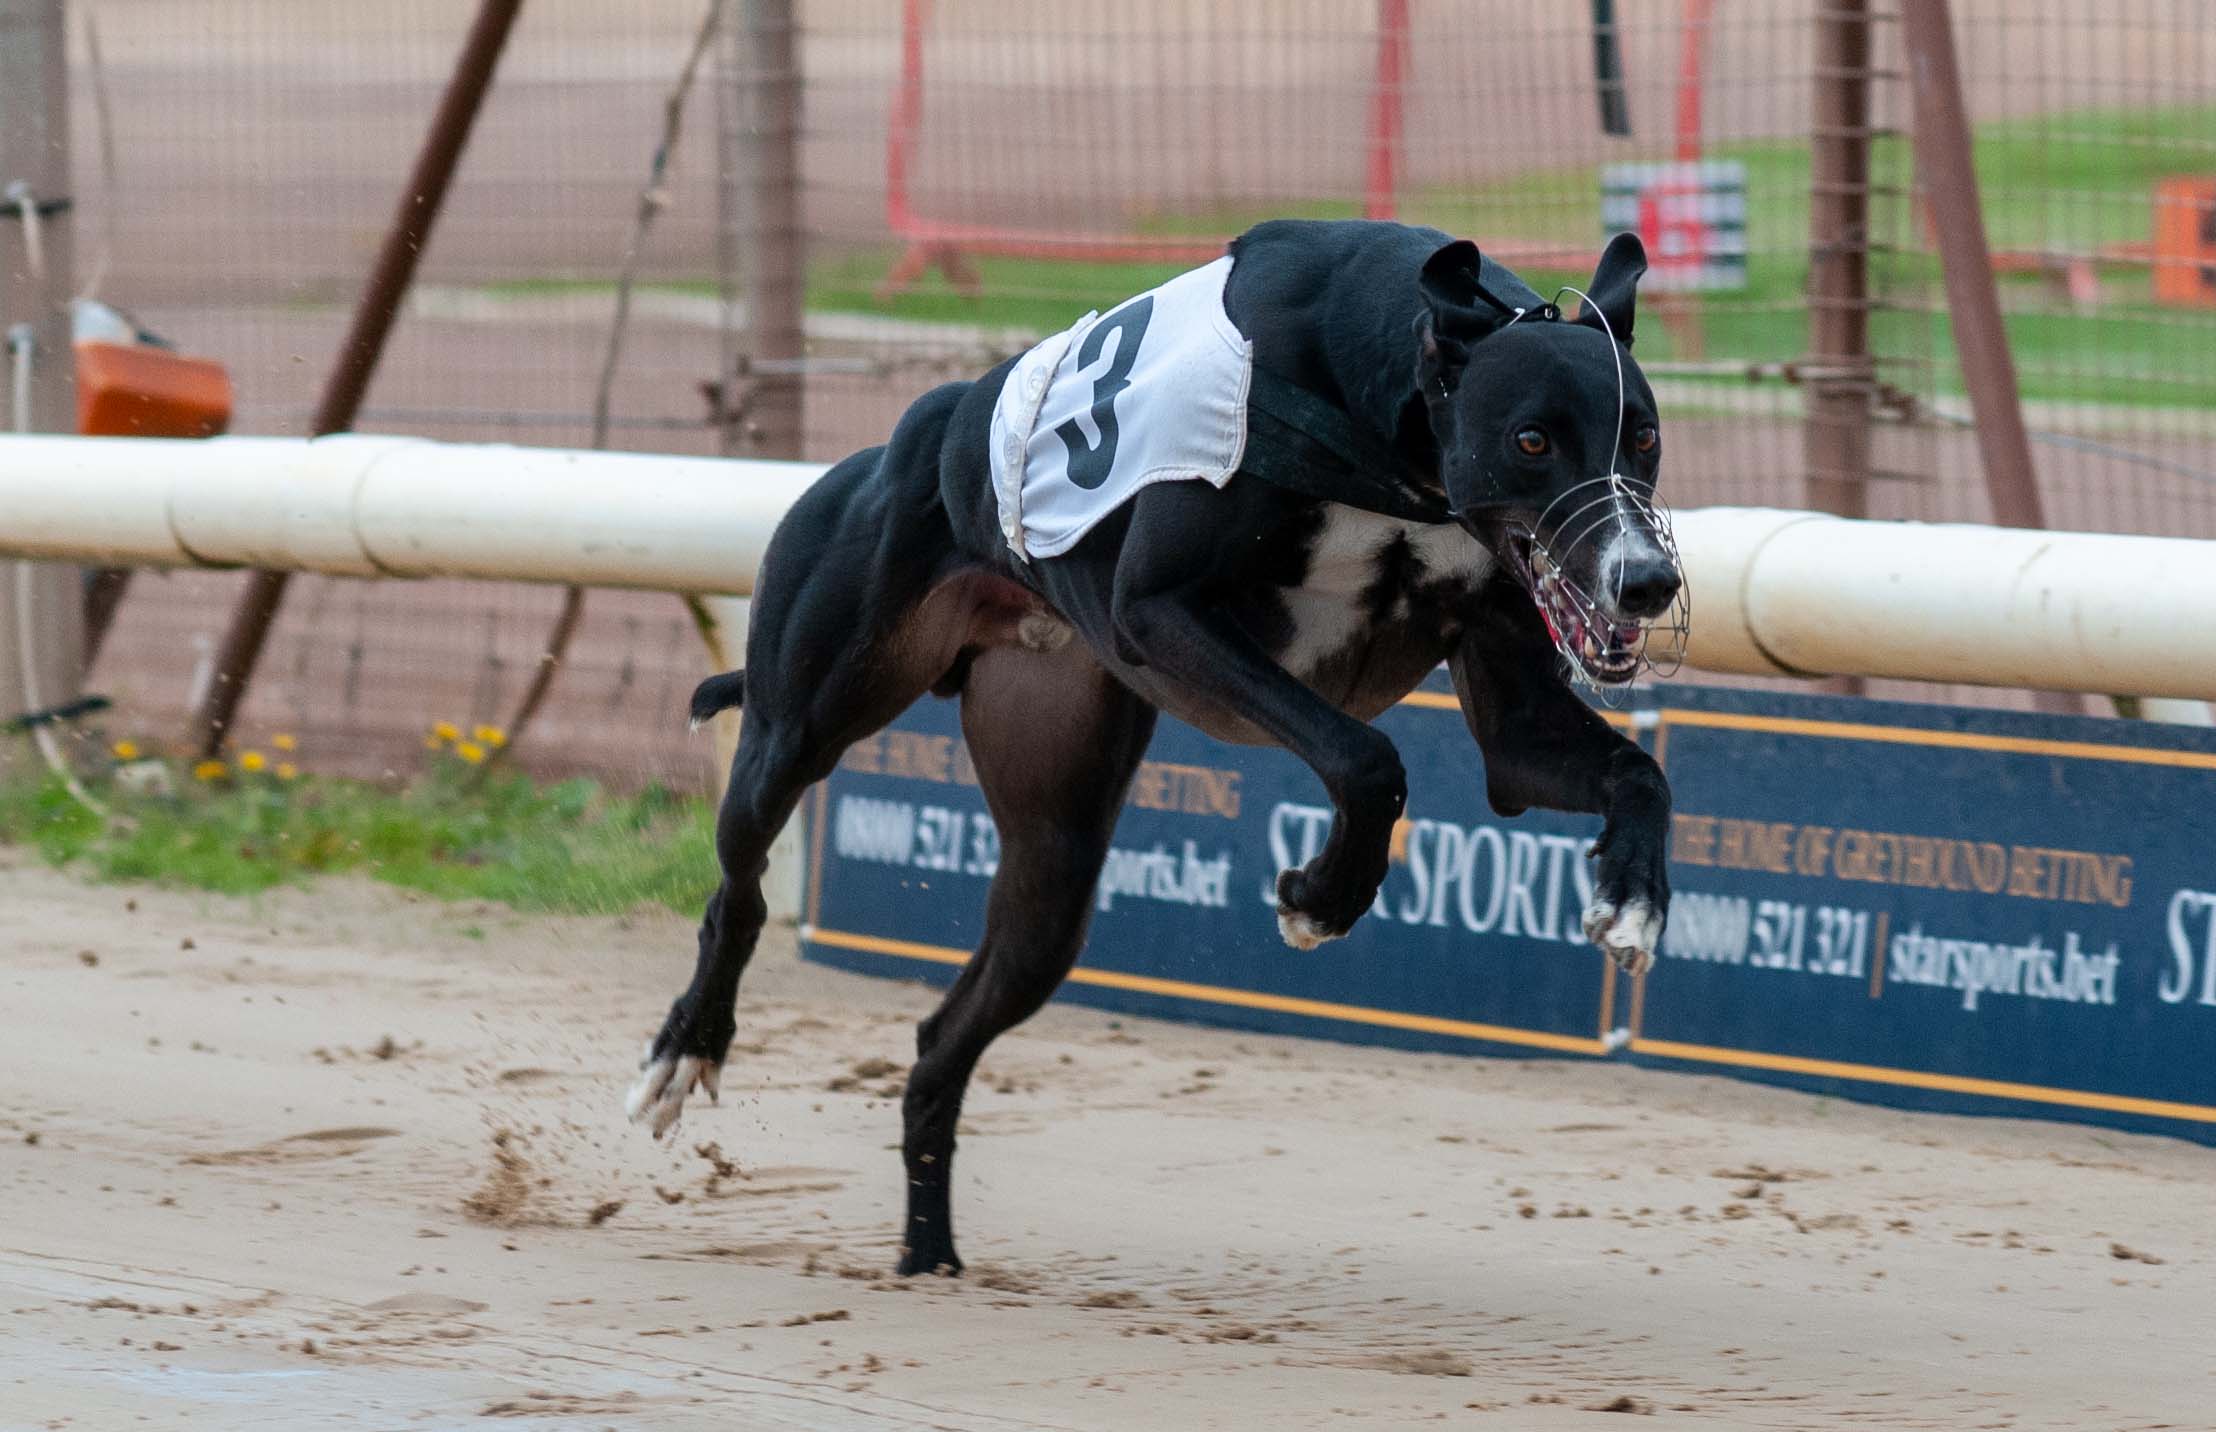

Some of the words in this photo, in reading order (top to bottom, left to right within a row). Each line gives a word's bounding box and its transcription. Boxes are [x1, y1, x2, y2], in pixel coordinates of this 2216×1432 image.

[1054, 295, 1154, 490] 3
[1132, 761, 1242, 821] BETTING
[914, 804, 964, 873] 521
[966, 812, 1002, 877] 32
[1099, 839, 1231, 912] ports.bet
[1717, 818, 1795, 875] HOME
[1795, 824, 1835, 877] OF
[1834, 829, 2006, 895] GREYHOUND
[2006, 845, 2133, 908] BETTING
[1750, 899, 1808, 971] 521
[1807, 905, 1871, 979] 321
[1888, 922, 2121, 1011] starsports.bet
[2157, 888, 2216, 1007] ST
